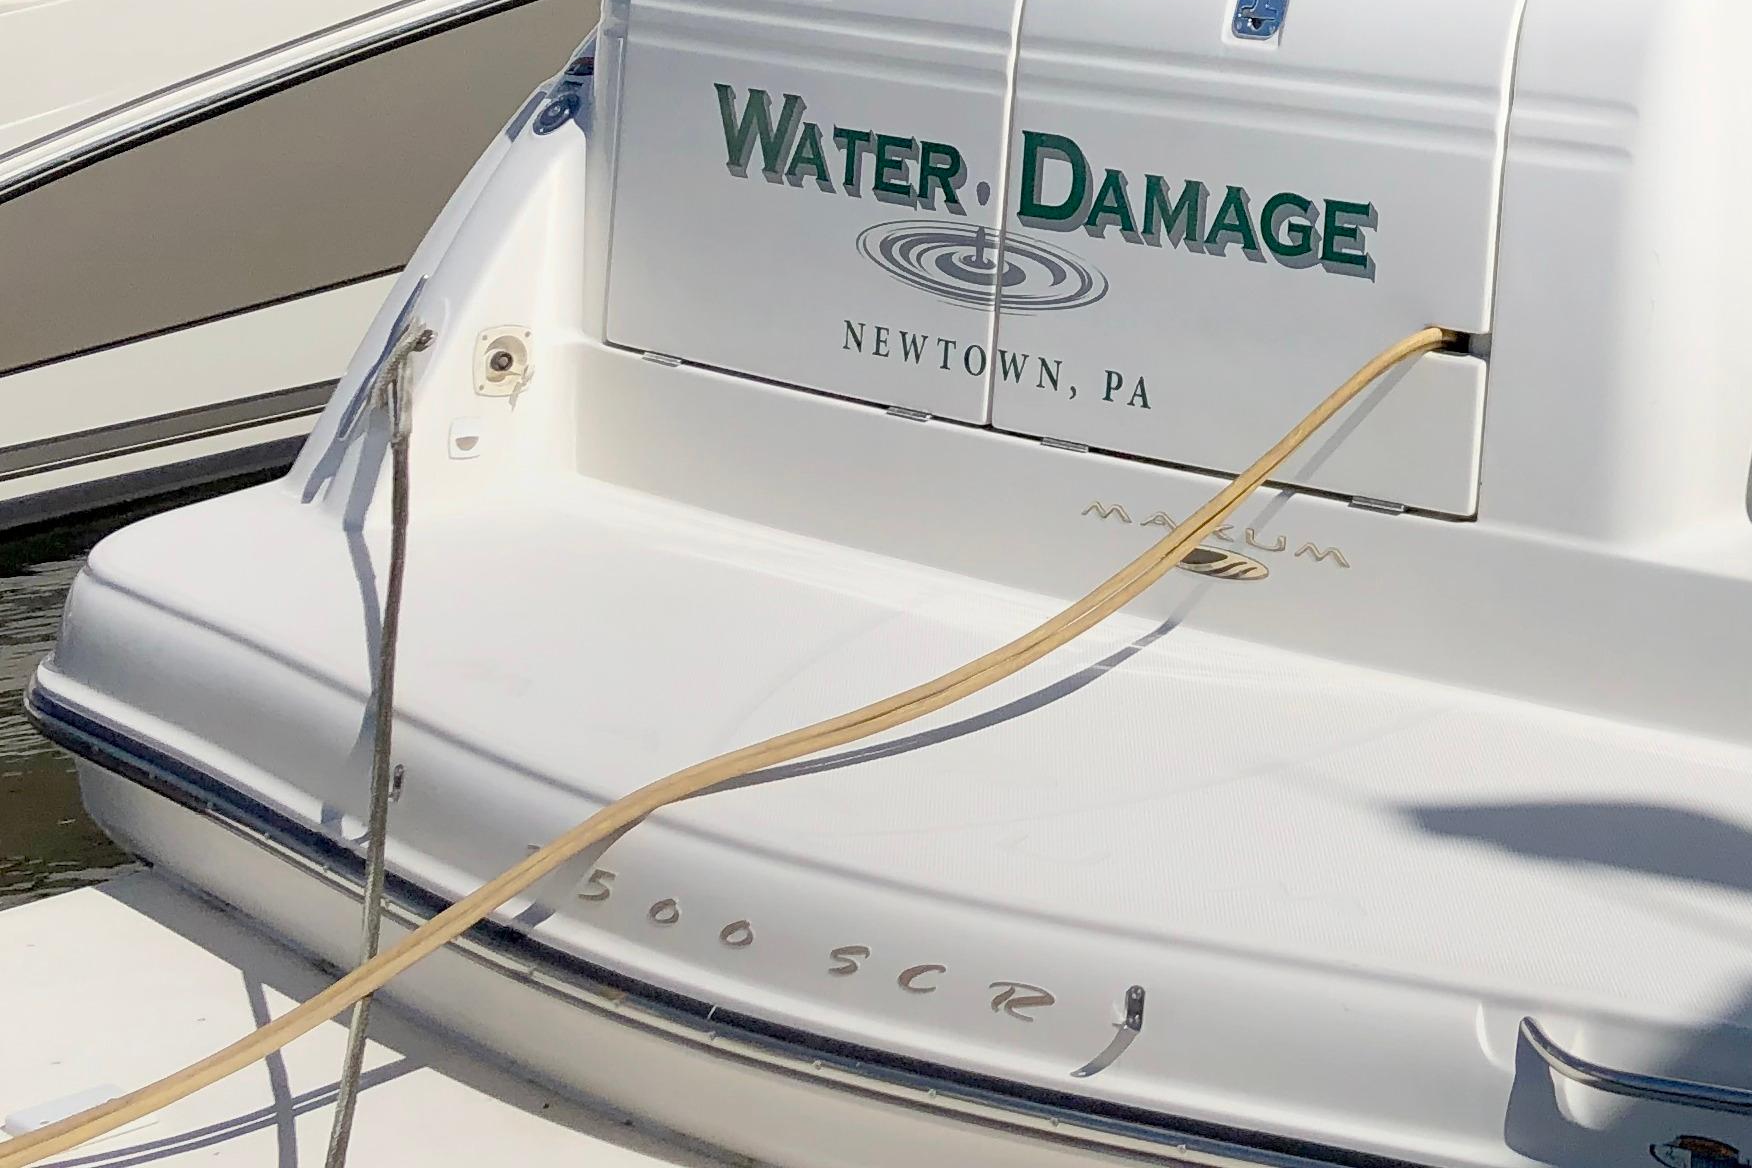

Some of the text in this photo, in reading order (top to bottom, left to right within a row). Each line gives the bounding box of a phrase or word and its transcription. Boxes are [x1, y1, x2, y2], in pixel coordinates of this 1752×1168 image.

[1016, 129, 1379, 283] DAMAGE
[842, 319, 1152, 410] NEWTOWN, PA
[526, 842, 1056, 1023] 500 SCR
